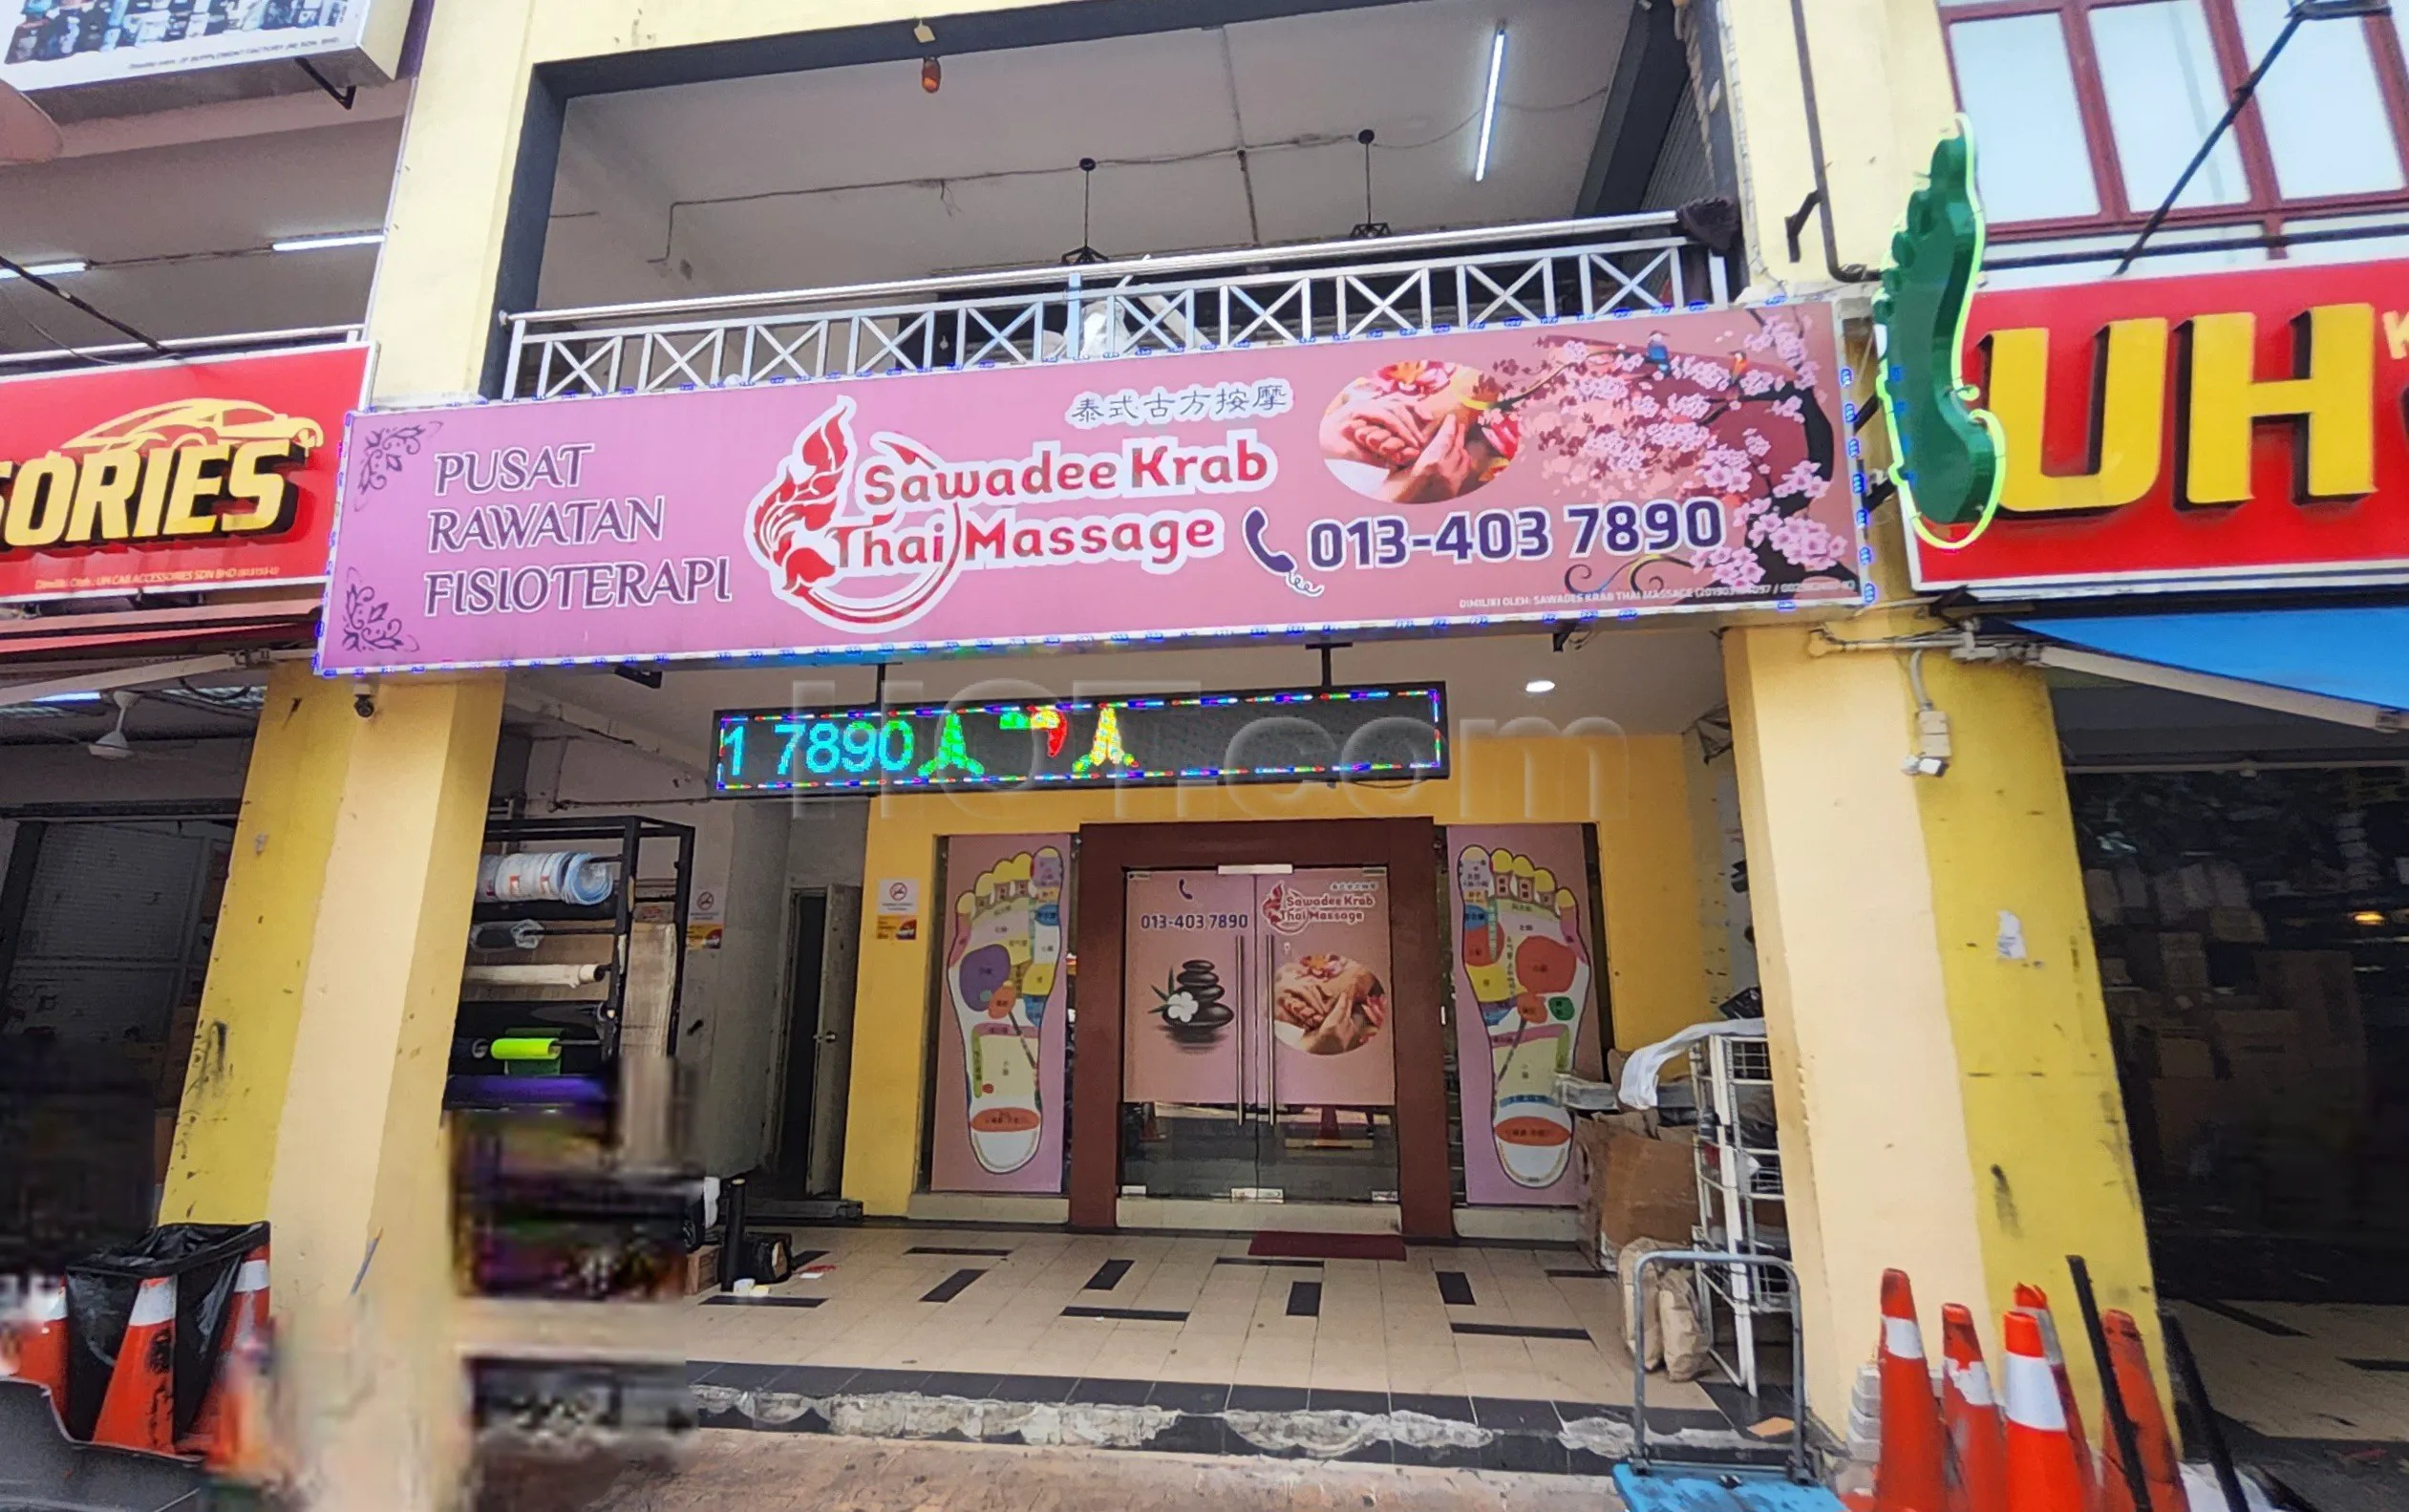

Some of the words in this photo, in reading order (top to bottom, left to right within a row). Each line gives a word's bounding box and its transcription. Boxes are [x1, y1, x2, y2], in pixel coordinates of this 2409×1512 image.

[1072, 384, 1288, 423] 泰式古方按摩
[1983, 302, 2377, 512] UH
[435, 443, 594, 496] PUSAT
[864, 450, 1117, 505] Sawadee
[1131, 438, 1268, 487] Krab
[428, 495, 666, 553] RAWATAN
[827, 516, 945, 568] Thai
[965, 517, 1215, 564] Massage
[1309, 511, 1550, 567] 013-403
[1567, 500, 1721, 558] 7890
[424, 556, 733, 616] FISIOTERAPI
[774, 719, 915, 776] 7890
[1141, 913, 1204, 929] 013-403
[1210, 912, 1248, 929] 7890
[1279, 910, 1307, 922] Thai
[1308, 910, 1364, 925] Massage
[1343, 894, 1374, 907] Krab
